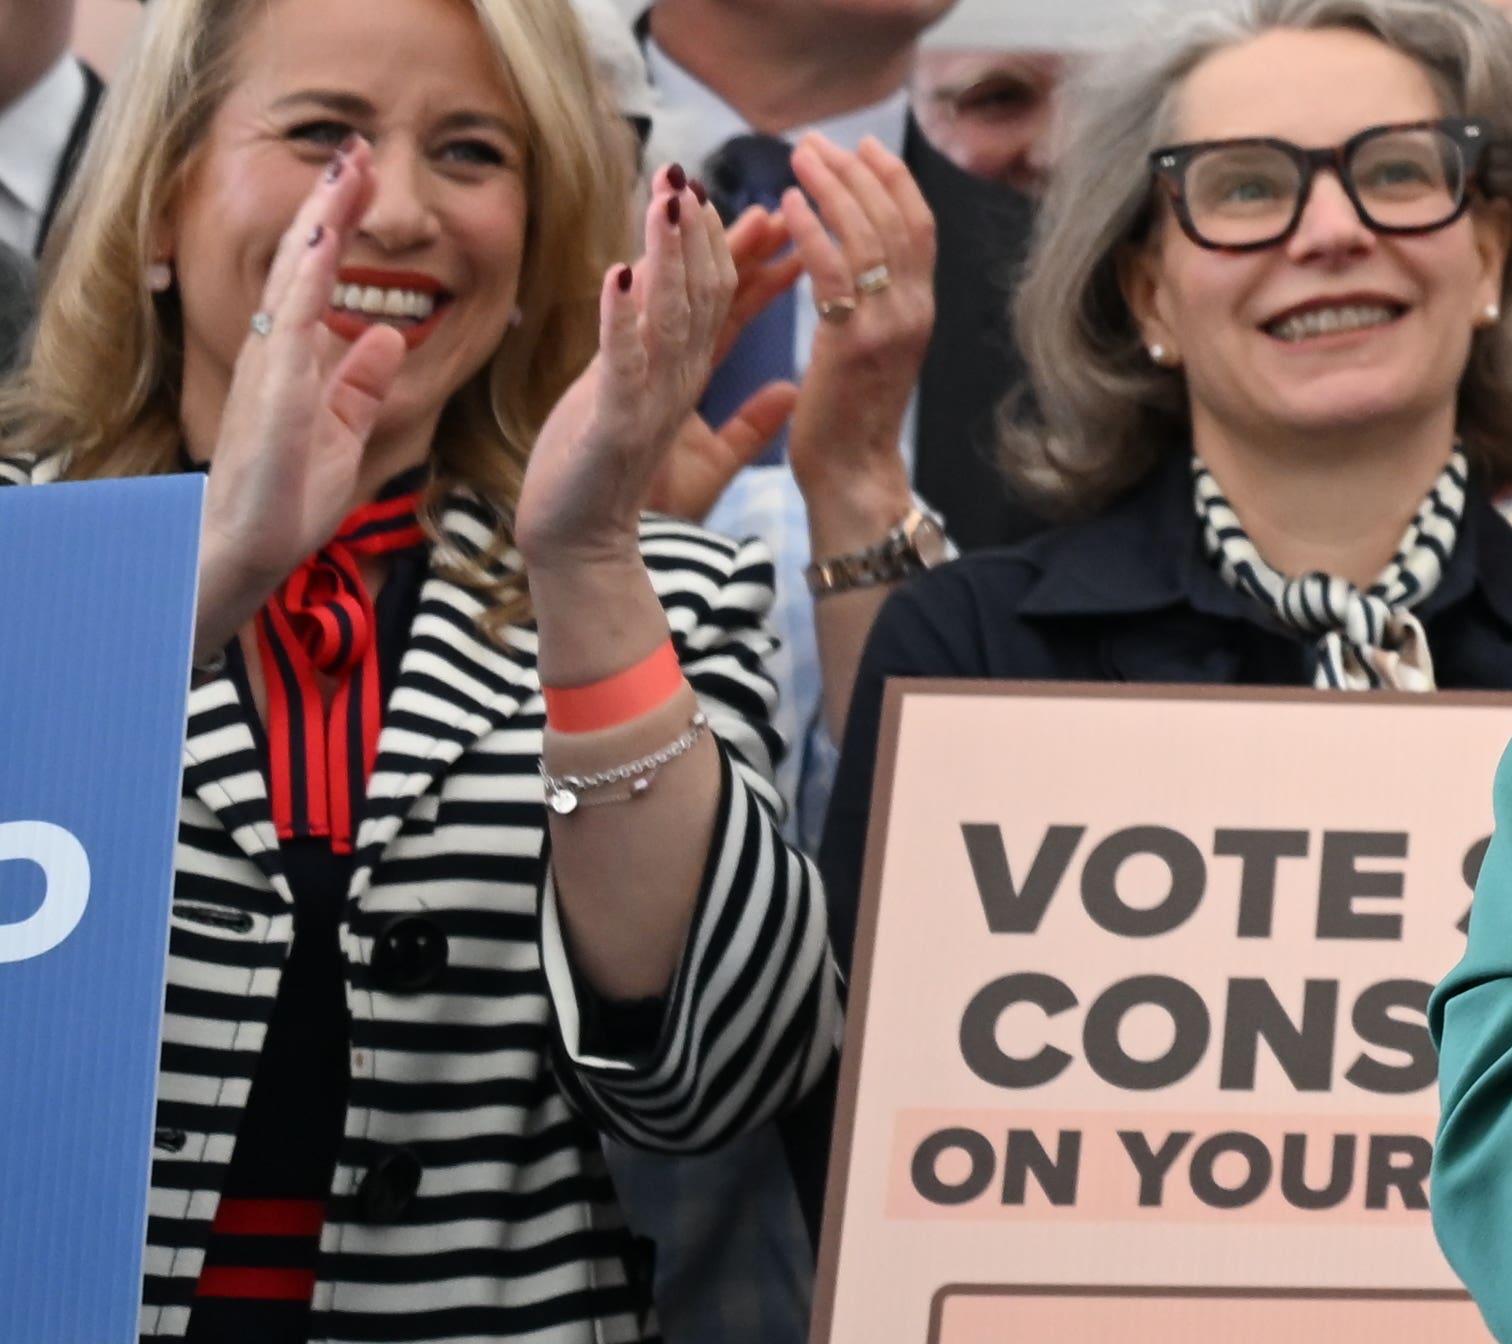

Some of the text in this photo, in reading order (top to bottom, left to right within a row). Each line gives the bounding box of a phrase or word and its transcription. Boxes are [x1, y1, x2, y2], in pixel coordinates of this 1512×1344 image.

[960, 822, 1409, 941] VOTE
[910, 1126, 1431, 1211] ON YOUR
